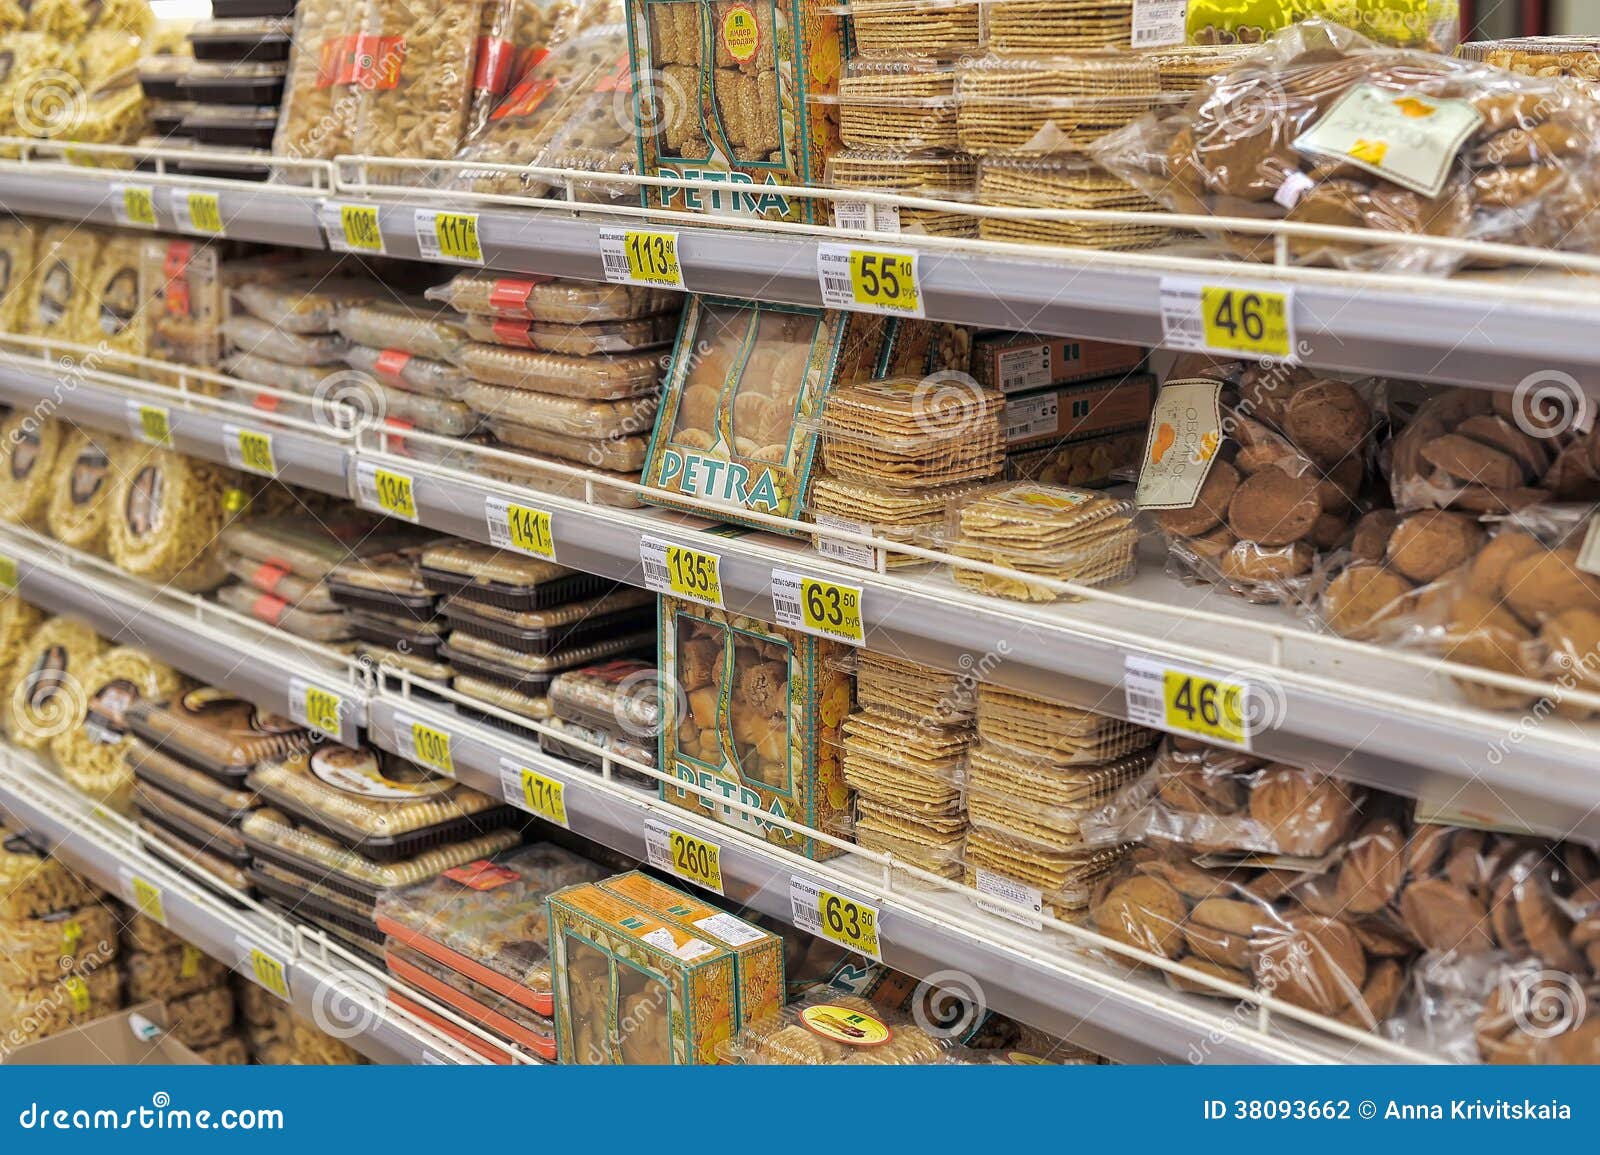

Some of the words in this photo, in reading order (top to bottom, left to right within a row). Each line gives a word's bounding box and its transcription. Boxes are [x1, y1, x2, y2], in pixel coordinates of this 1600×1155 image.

[658, 167, 790, 217] PETRA
[441, 216, 468, 251] 117
[632, 235, 667, 274] 113
[666, 241, 673, 253] 90
[861, 255, 899, 298] 55
[900, 262, 912, 276] 10
[1215, 291, 1264, 340] 46
[381, 475, 406, 510] 134
[658, 449, 779, 511] PETRA
[513, 509, 542, 547] 141
[673, 549, 708, 591] 135
[707, 560, 715, 573] 30
[807, 583, 843, 625] 63
[844, 593, 855, 607] 50
[846, 616, 860, 627] руб
[1175, 677, 1219, 726] 46
[417, 728, 443, 762] 130
[527, 776, 555, 814] 171
[676, 761, 793, 839] PETRA
[675, 836, 709, 878] 260
[709, 851, 716, 863] 80
[826, 896, 860, 939] 63
[862, 912, 872, 926] 50
